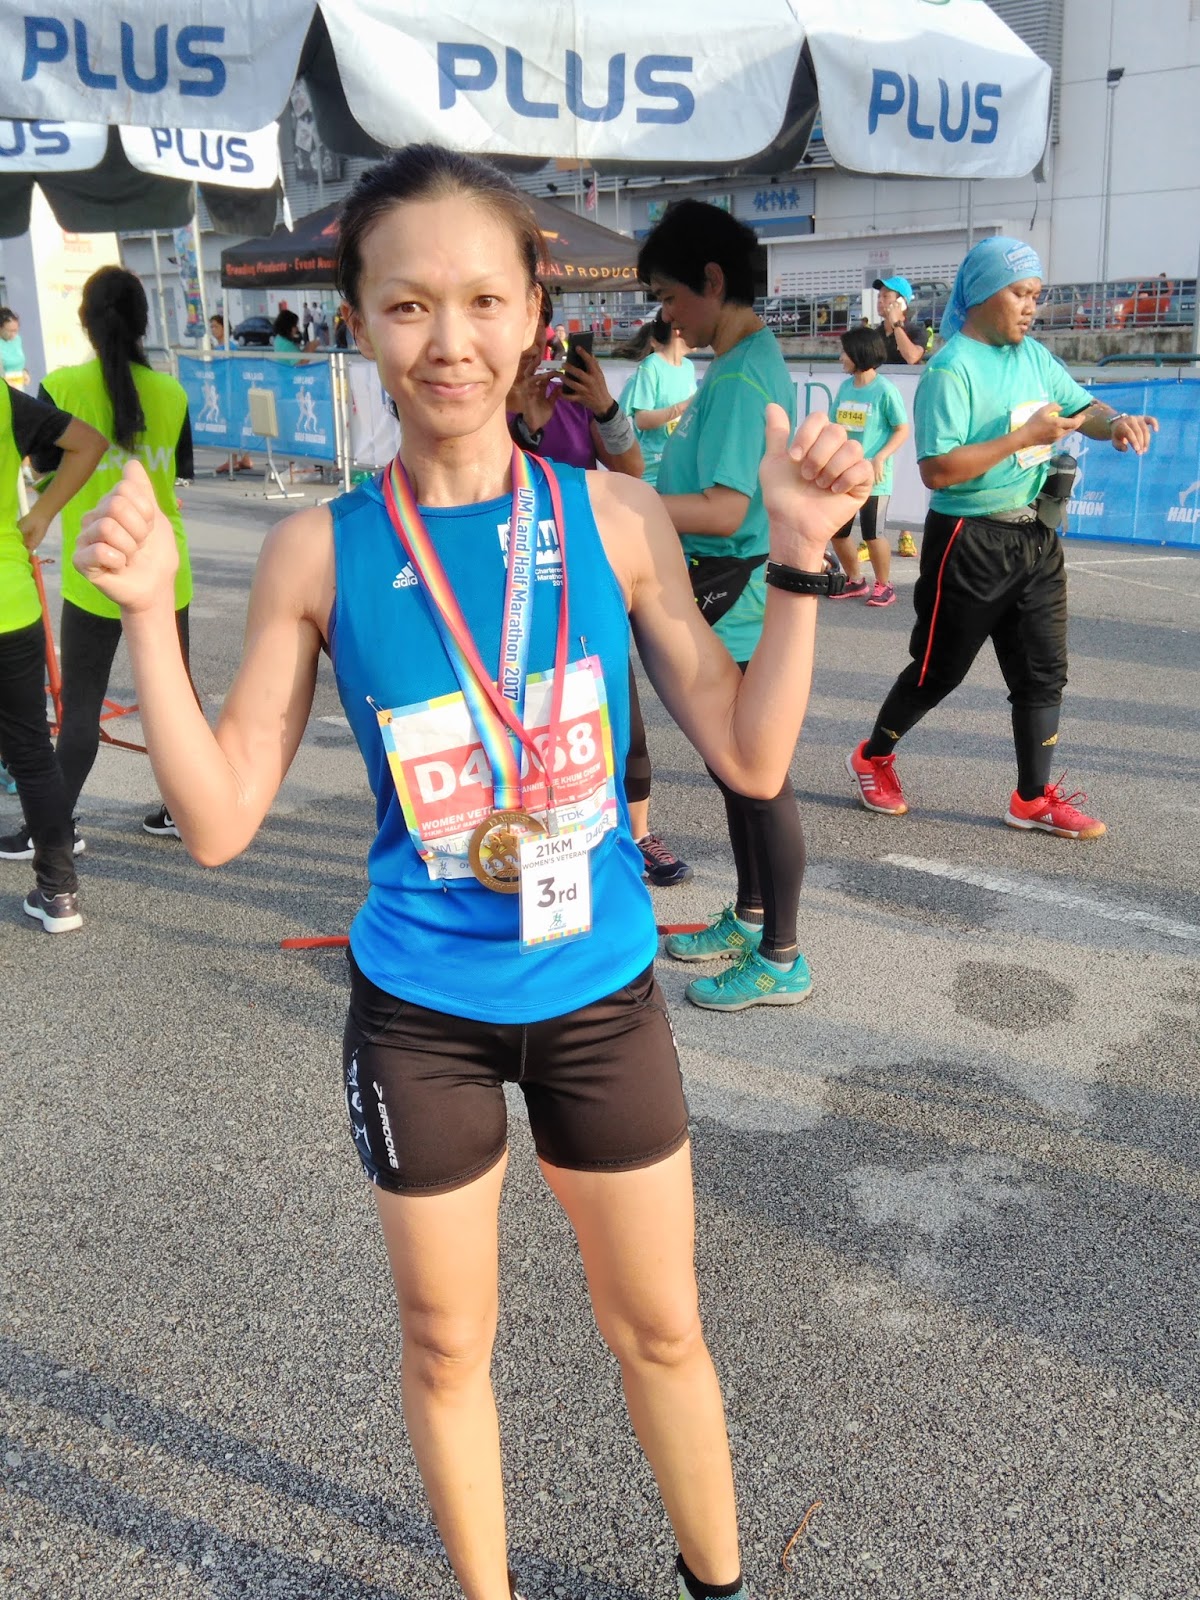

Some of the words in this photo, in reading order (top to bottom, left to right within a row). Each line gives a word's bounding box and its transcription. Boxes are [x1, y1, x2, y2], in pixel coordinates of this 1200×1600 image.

[22, 16, 227, 97] PLUS
[437, 42, 695, 125] PLUS
[868, 68, 1002, 144] PLUS
[153, 126, 254, 173] PLUS
[517, 488, 534, 513] IJM
[1167, 507, 1200, 523] HALF
[516, 516, 532, 552] Land
[513, 556, 529, 586] Half
[505, 589, 528, 661] Marathon
[503, 668, 520, 700] 2017
[522, 782, 544, 793] ANNIE
[422, 814, 464, 831] WOMEN
[558, 810, 584, 822] TDK
[522, 856, 555, 870] WOMEN'S
[556, 850, 587, 862] VETERAN
[536, 838, 573, 858] 21KM
[537, 877, 577, 908] 3rd
[378, 1102, 399, 1169] BROOKS
